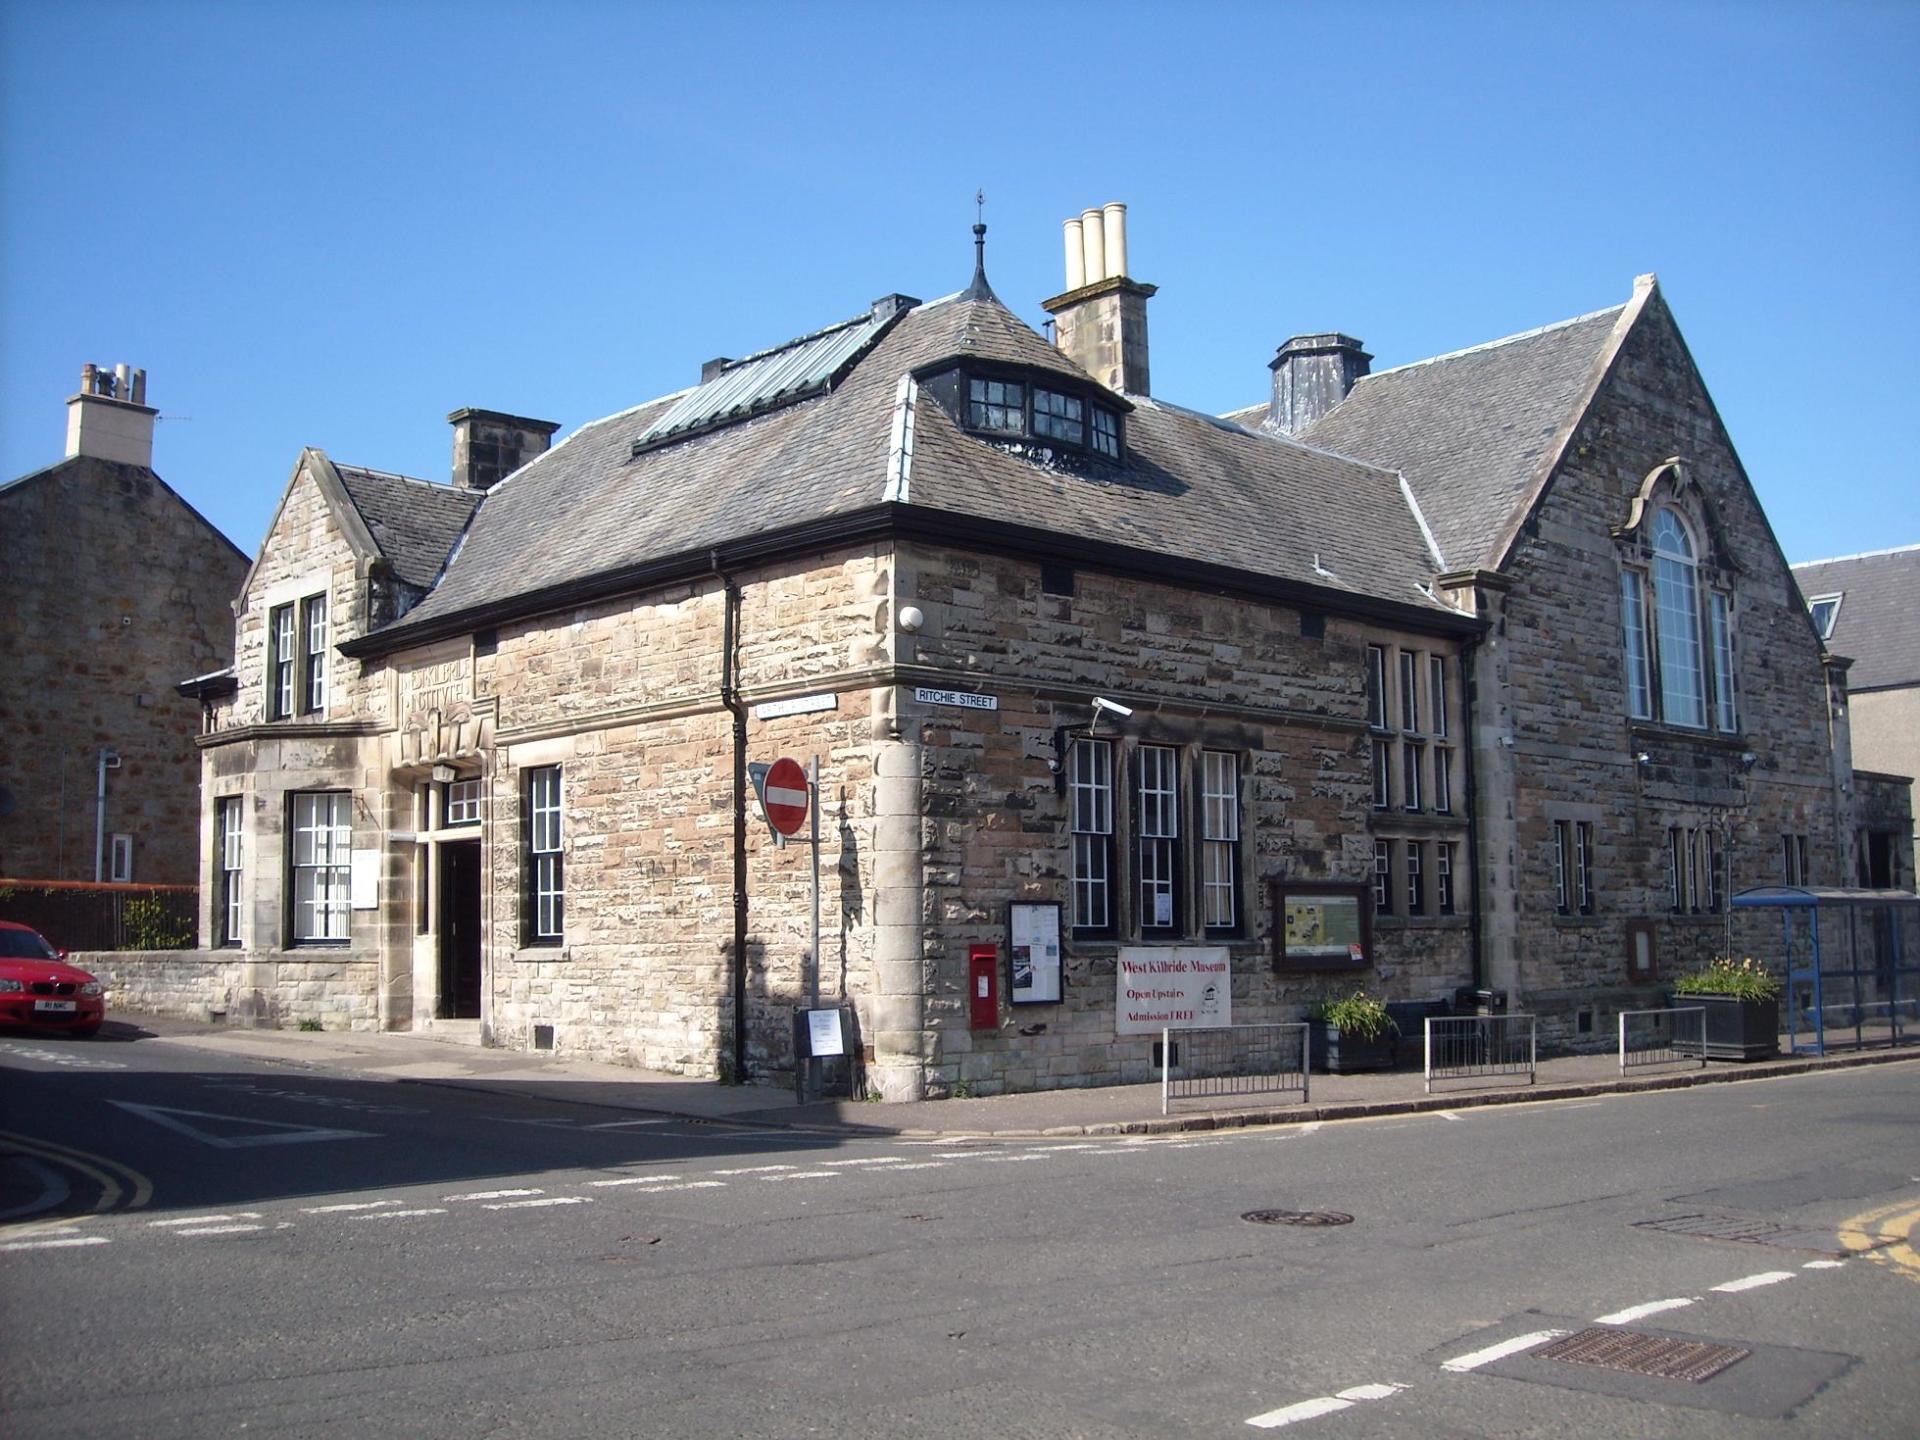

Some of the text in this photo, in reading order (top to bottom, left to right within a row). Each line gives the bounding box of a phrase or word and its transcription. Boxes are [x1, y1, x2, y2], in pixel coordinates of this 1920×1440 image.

[919, 690, 994, 708] RITCHIE STREET
[1122, 960, 1226, 974] West Kilbride Museum
[1126, 988, 1185, 1001] Open Upstairs
[1128, 1011, 1169, 1022] Admission
[1170, 1010, 1195, 1020] FREE
